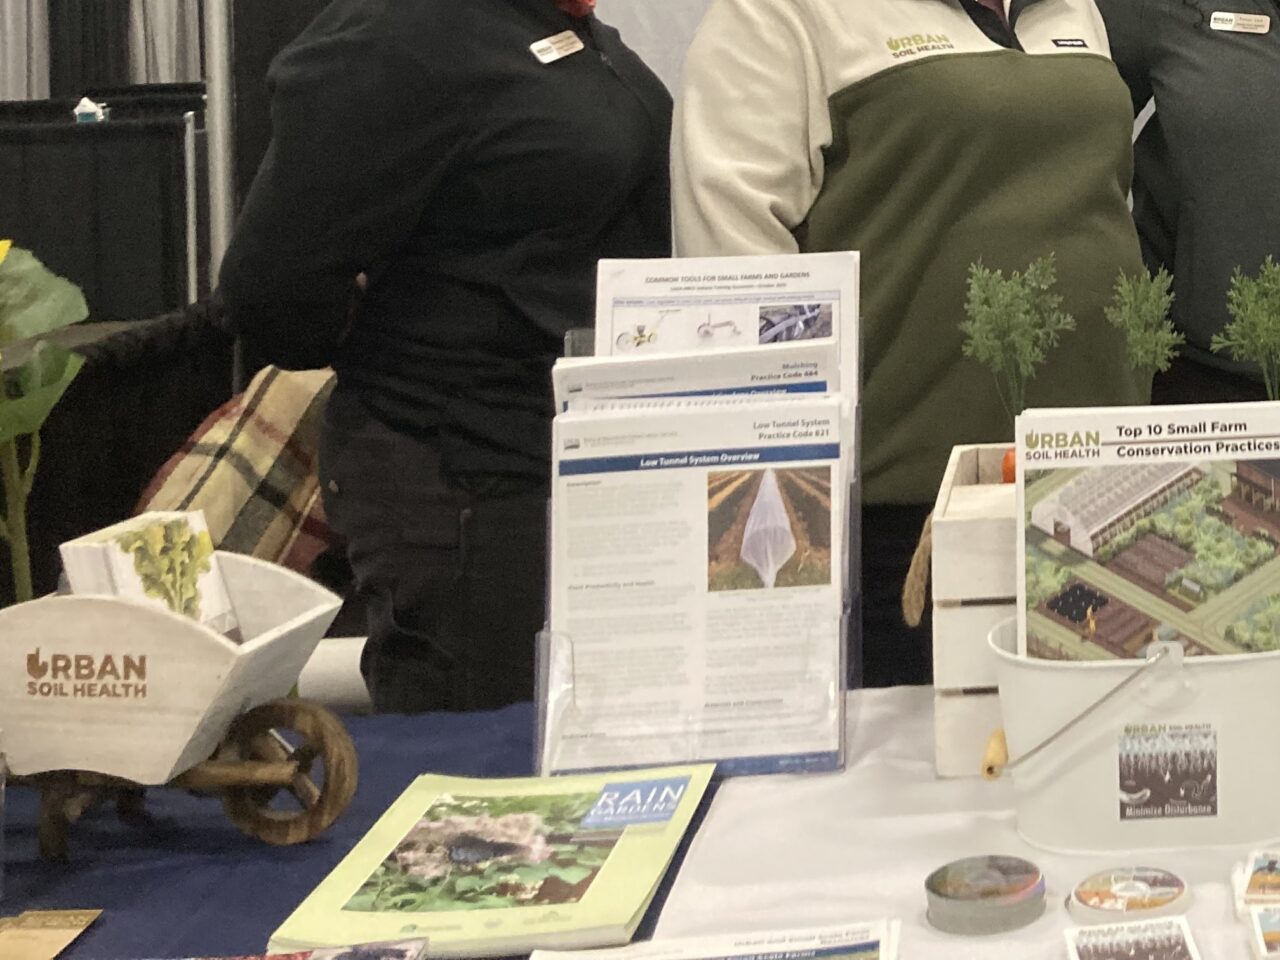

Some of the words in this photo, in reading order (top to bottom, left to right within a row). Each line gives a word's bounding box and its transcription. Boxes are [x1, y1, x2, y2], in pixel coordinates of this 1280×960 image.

[887, 34, 950, 51] URBAN
[892, 49, 917, 59] SOIL
[916, 43, 954, 52] HEALTH
[681, 275, 702, 283] TOOLS
[703, 275, 716, 283] FOR
[717, 274, 739, 282] SMALL
[764, 272, 779, 280] AND
[780, 271, 811, 280] GARDENS
[751, 373, 782, 382] Practice
[783, 372, 803, 380] Code
[753, 421, 770, 430] Low
[773, 420, 799, 429] Tunnel
[801, 418, 830, 429] System
[1116, 425, 1143, 438] Top
[1147, 423, 1163, 436] 10
[1167, 421, 1207, 435] Small
[1211, 420, 1248, 433] Farm
[758, 431, 791, 440] Practice
[793, 430, 813, 439] Code
[1025, 429, 1100, 450] URBAN
[1025, 450, 1052, 460] SOIL
[1055, 448, 1100, 459] HEALTH
[1116, 441, 1212, 457] Conservation
[1215, 439, 1280, 453] Practices
[640, 458, 658, 467] Low
[660, 456, 688, 466] Tunnel
[689, 454, 720, 466] System
[721, 451, 761, 461] Overview
[27, 647, 147, 680] URBAN
[27, 681, 69, 697] SOIL
[73, 683, 147, 699] HEALTH
[1124, 723, 1167, 735] URBAN
[598, 784, 684, 806] RAIN
[1126, 806, 1163, 817] Minimize
[1165, 802, 1212, 815] Disturbance
